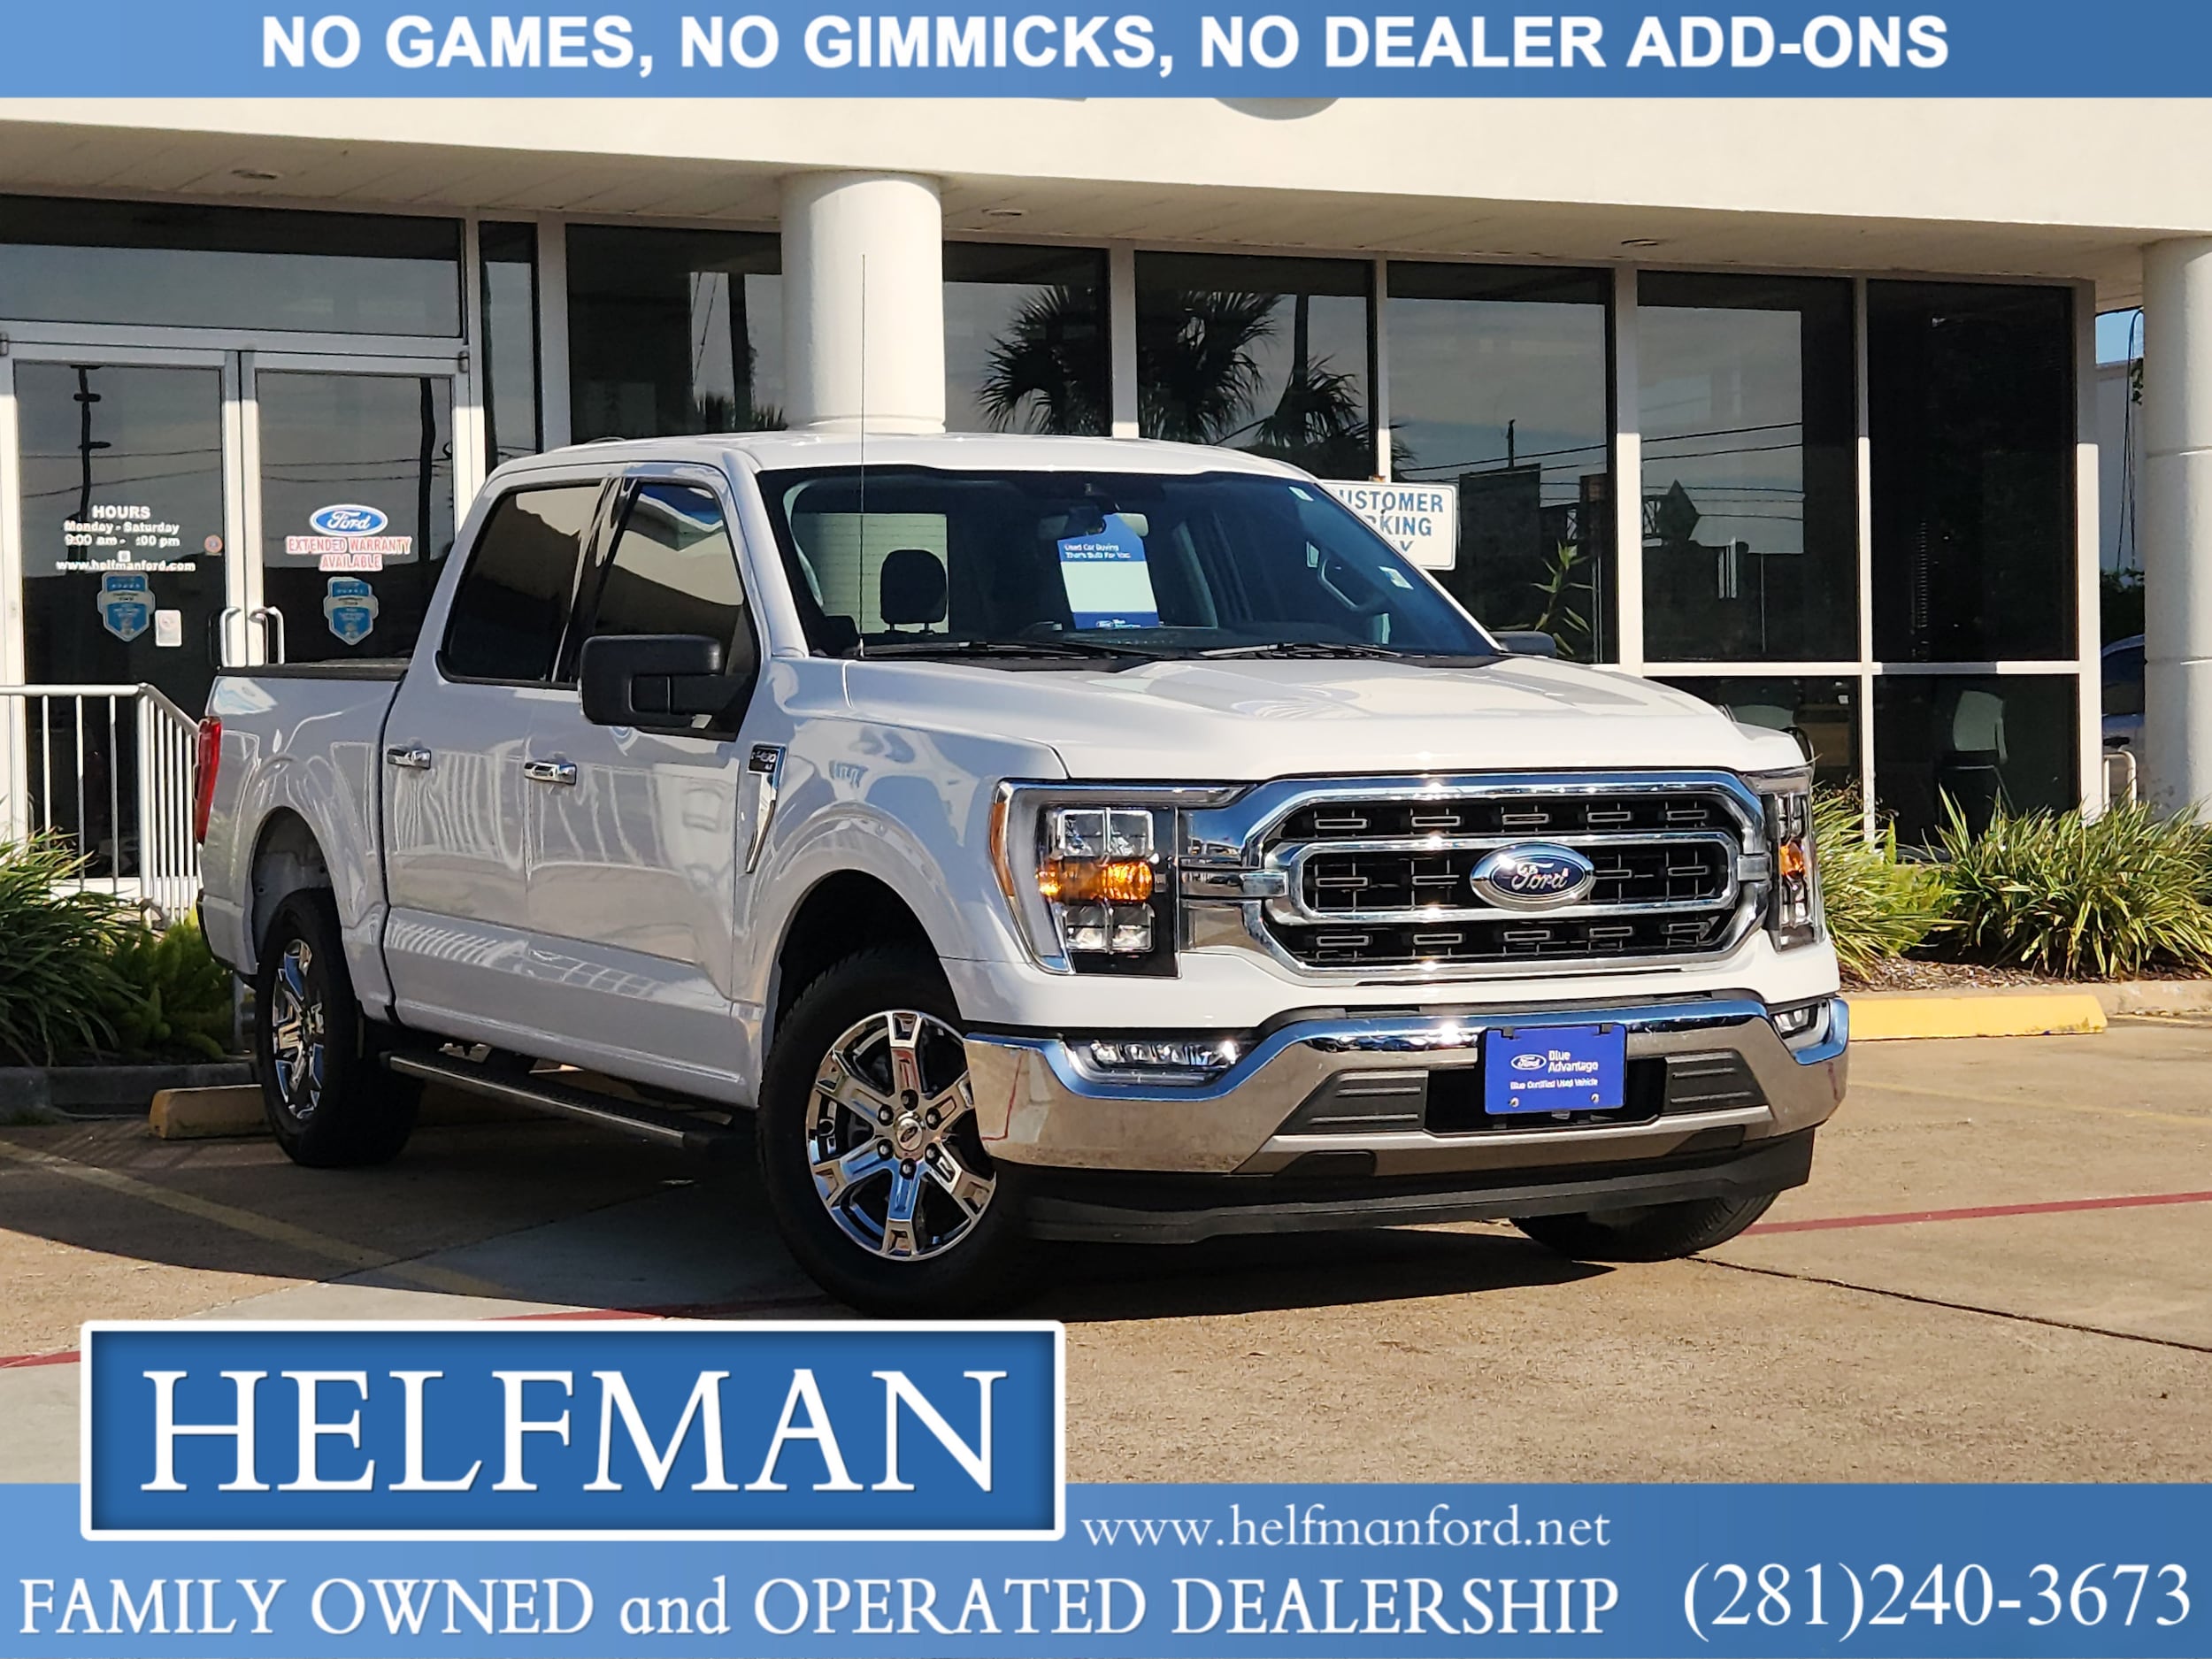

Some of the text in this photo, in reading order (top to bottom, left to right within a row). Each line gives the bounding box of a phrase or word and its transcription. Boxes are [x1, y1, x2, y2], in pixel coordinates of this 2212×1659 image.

[1339, 489, 1443, 512] USTOMER
[92, 505, 151, 518] HOURS
[327, 511, 372, 529] Ford
[64, 520, 114, 534] Monday
[123, 521, 180, 535] Saturday
[96, 535, 118, 546] am
[158, 536, 180, 548] pm
[288, 538, 411, 553] EXTENDED WARRANTY
[56, 559, 196, 572] www.helfmanford.com
[321, 555, 381, 569] AVAILABLE
[1511, 862, 1570, 891] Ford
[1548, 1049, 1571, 1061] Blue
[1548, 1060, 1599, 1073] Advantage
[1509, 1081, 1526, 1090] Blue
[1556, 1078, 1574, 1088] Used
[1574, 1077, 1599, 1087] Vehicle
